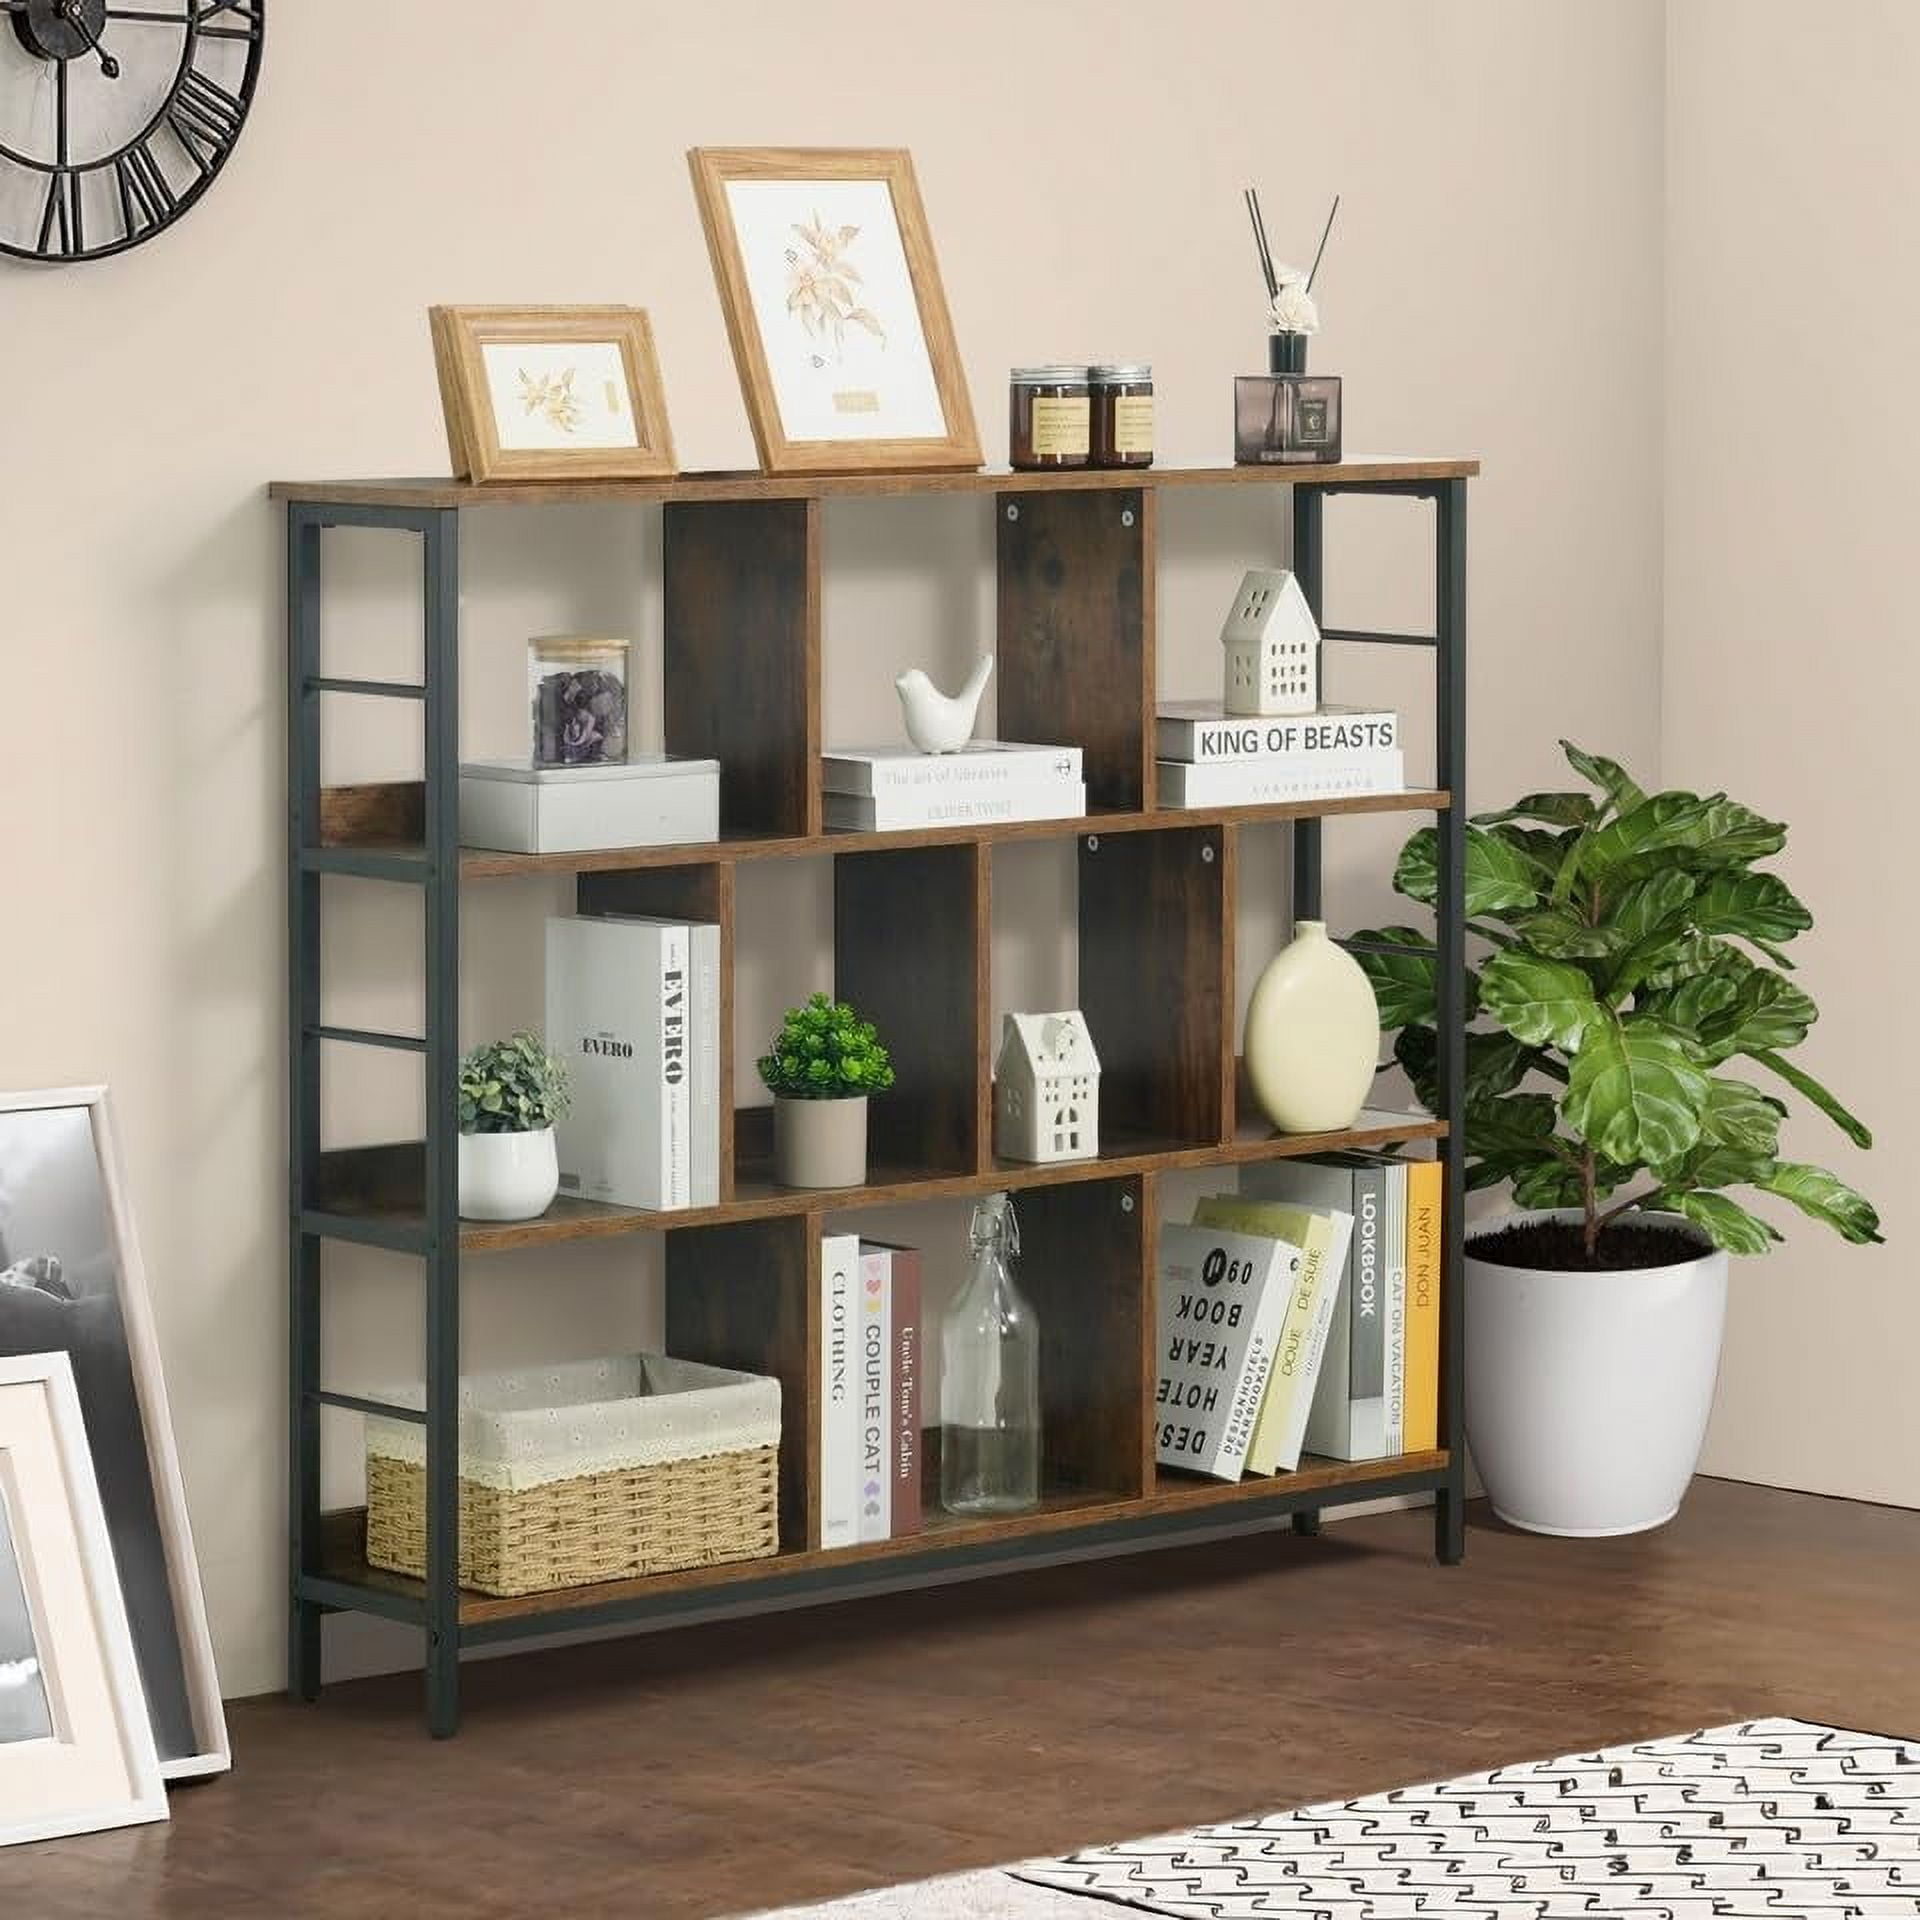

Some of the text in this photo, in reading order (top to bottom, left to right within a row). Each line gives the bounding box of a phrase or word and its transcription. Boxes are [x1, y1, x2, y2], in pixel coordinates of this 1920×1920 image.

[1202, 722, 1394, 756] KING OF BEASTS
[582, 1038, 633, 1058] EVERO
[665, 970, 683, 1085] EVERO
[1360, 1193, 1376, 1317] LOOKBOOK
[1416, 1264, 1429, 1307] DON
[832, 1270, 847, 1402] CLOTHING
[1175, 1295, 1243, 1328] BOOK
[1391, 1272, 1402, 1425] CAT ON VACATION
[1169, 1336, 1229, 1370] YEAR
[865, 1324, 880, 1473] COUPLE CAT
